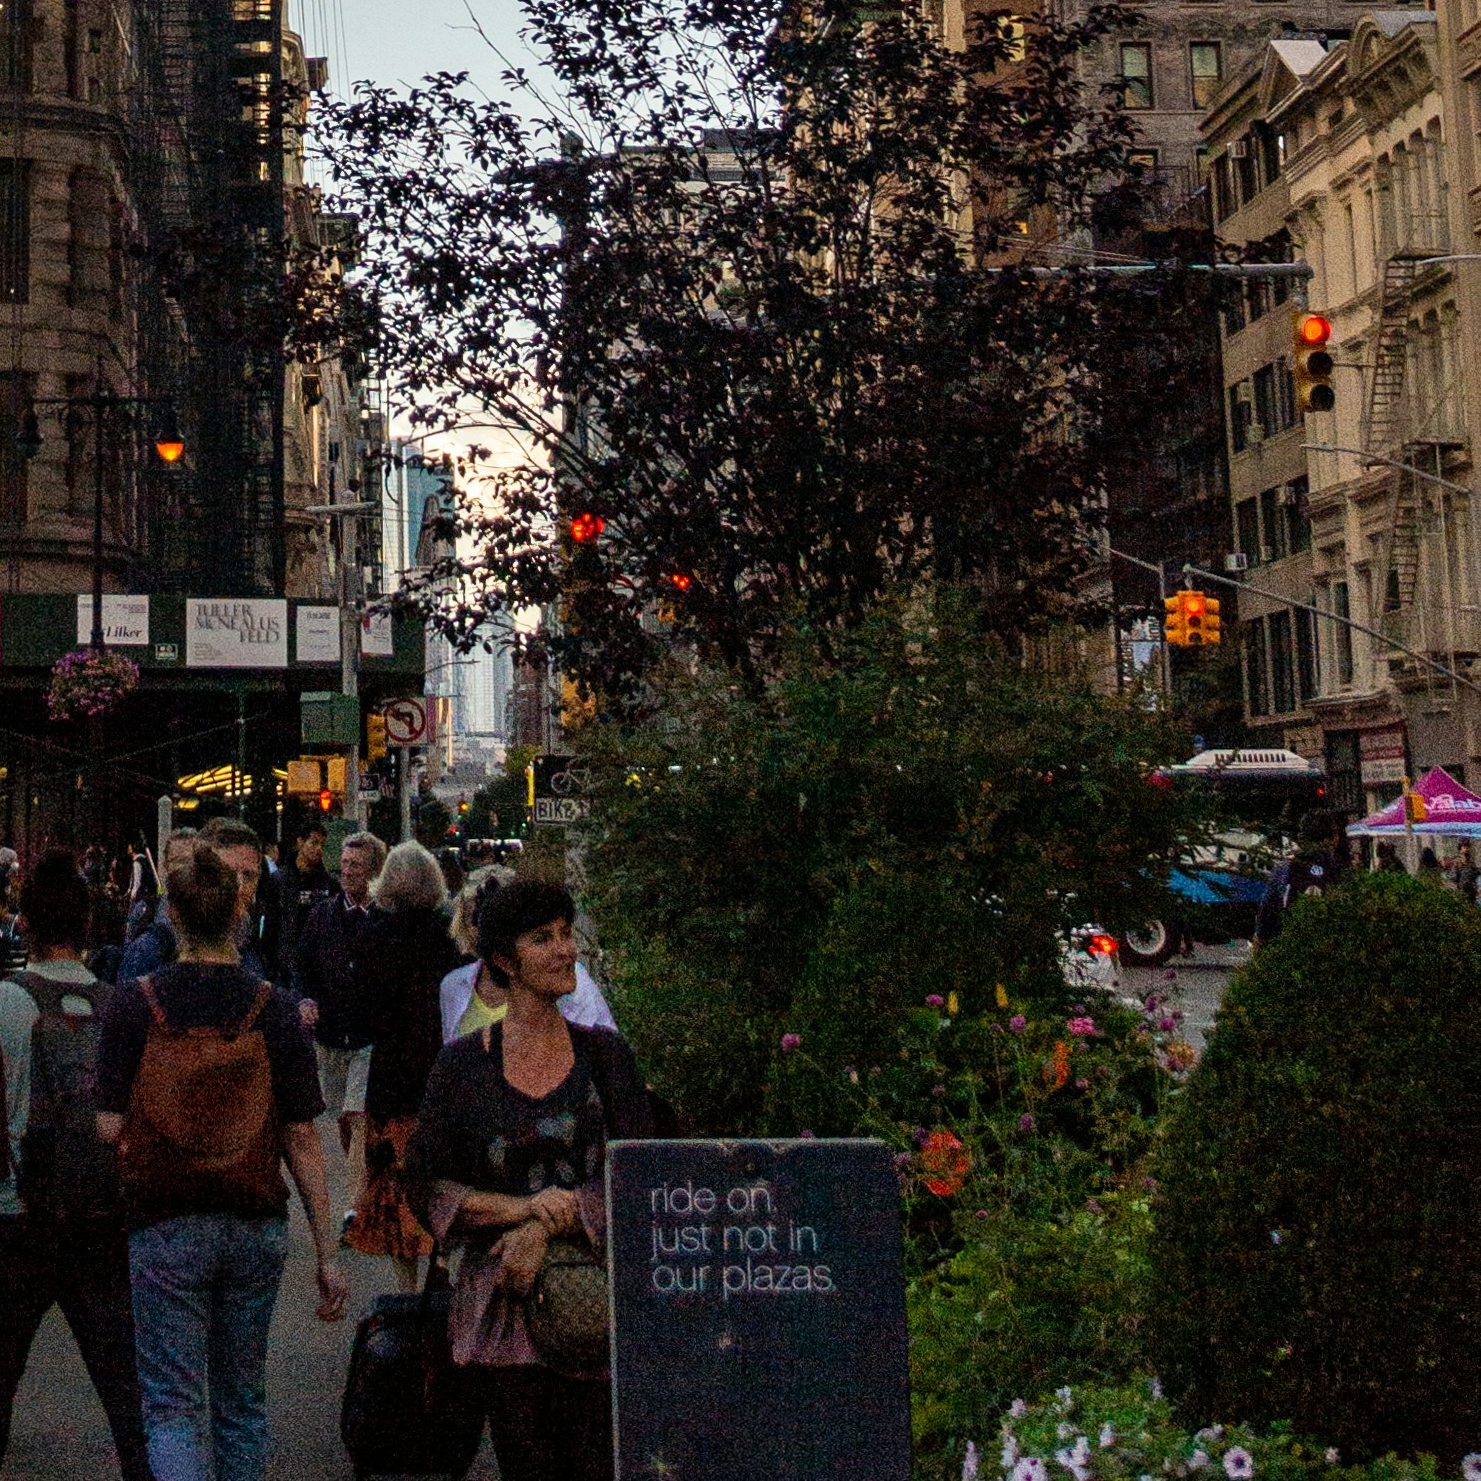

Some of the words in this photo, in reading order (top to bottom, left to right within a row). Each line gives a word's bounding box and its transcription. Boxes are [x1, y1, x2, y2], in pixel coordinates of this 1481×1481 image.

[650, 1181, 716, 1212] ride
[649, 1219, 711, 1263] just
[723, 1223, 777, 1251] not
[789, 1219, 818, 1252] in
[652, 1264, 710, 1291] our
